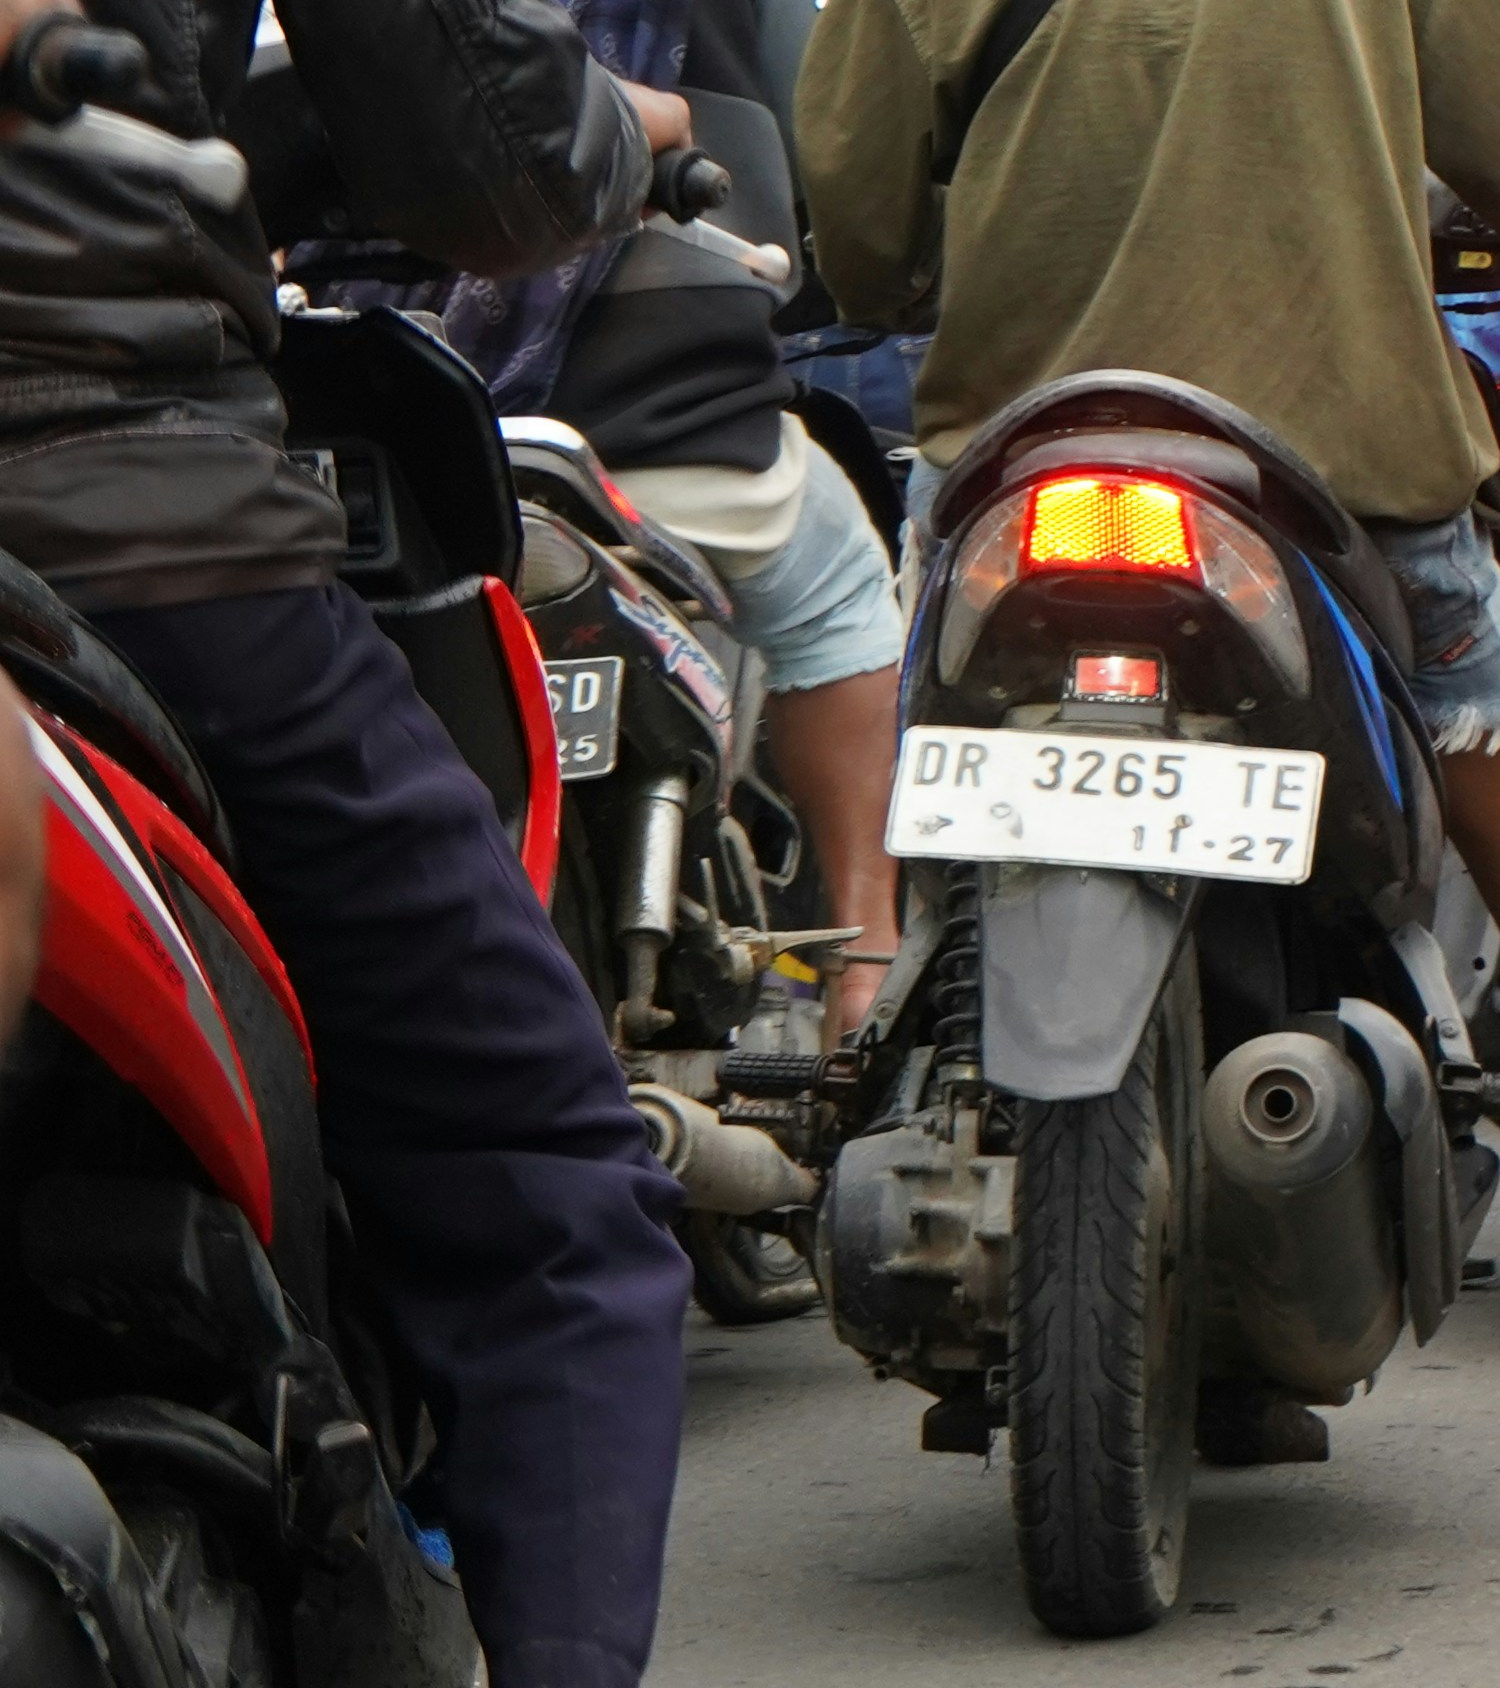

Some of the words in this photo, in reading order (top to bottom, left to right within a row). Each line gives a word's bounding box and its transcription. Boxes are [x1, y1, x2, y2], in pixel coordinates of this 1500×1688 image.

[913, 740, 989, 788] DR
[1032, 745, 1188, 800] 3265
[1236, 760, 1307, 812] TE
